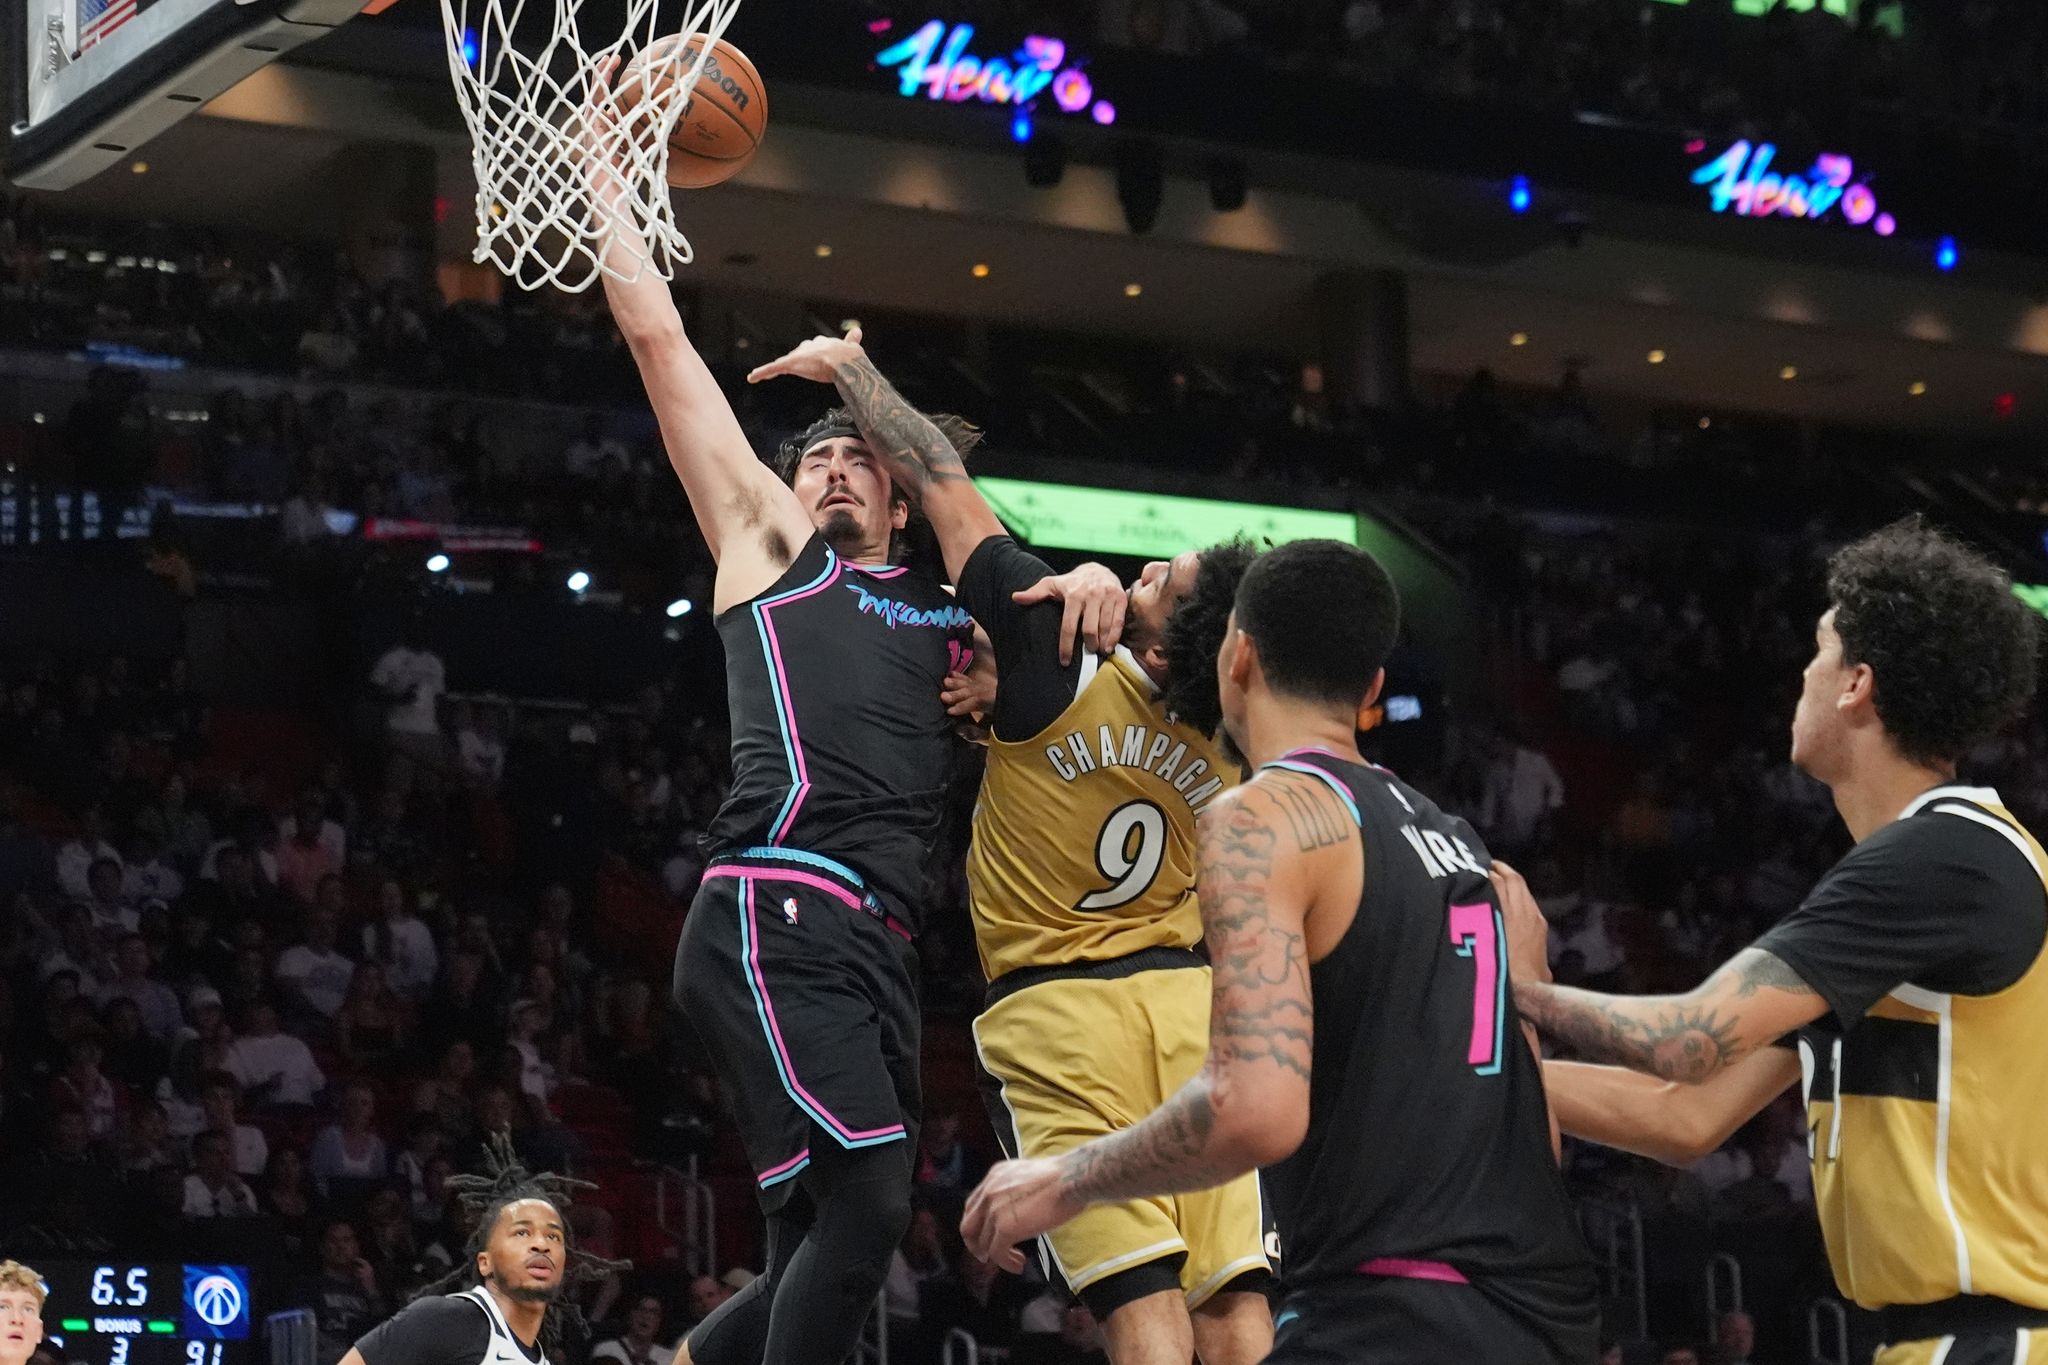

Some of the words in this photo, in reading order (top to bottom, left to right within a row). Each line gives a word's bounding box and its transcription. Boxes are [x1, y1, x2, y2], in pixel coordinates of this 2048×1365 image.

[1046, 723, 1225, 829] CHAMPAGN
[1071, 799, 1169, 912] 9
[1449, 902, 1507, 1077] 7
[90, 1266, 149, 1306] 6.5
[93, 1317, 142, 1334] BONUS
[108, 1335, 130, 1365] 3
